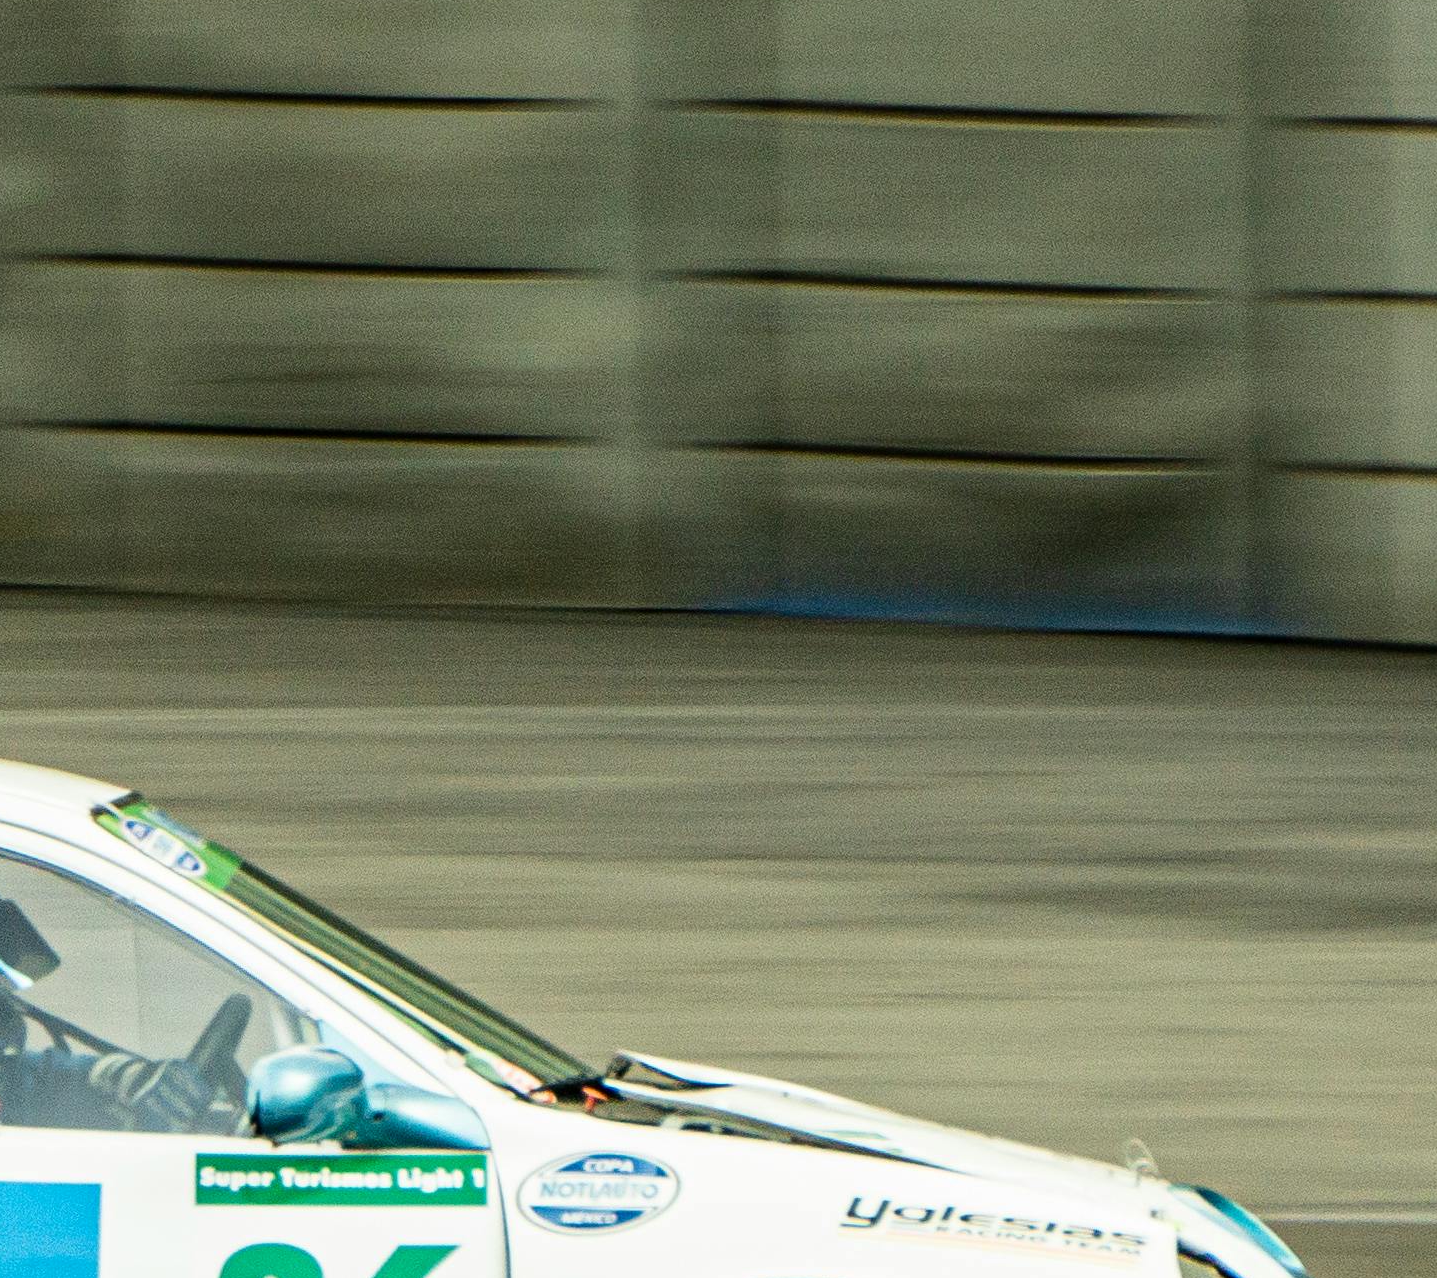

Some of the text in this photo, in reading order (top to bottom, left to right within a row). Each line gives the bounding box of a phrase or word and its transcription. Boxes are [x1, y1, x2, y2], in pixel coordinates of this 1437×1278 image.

[200, 1167, 275, 1192] Super
[280, 1167, 392, 1189] Turismos
[397, 1167, 464, 1193] Light
